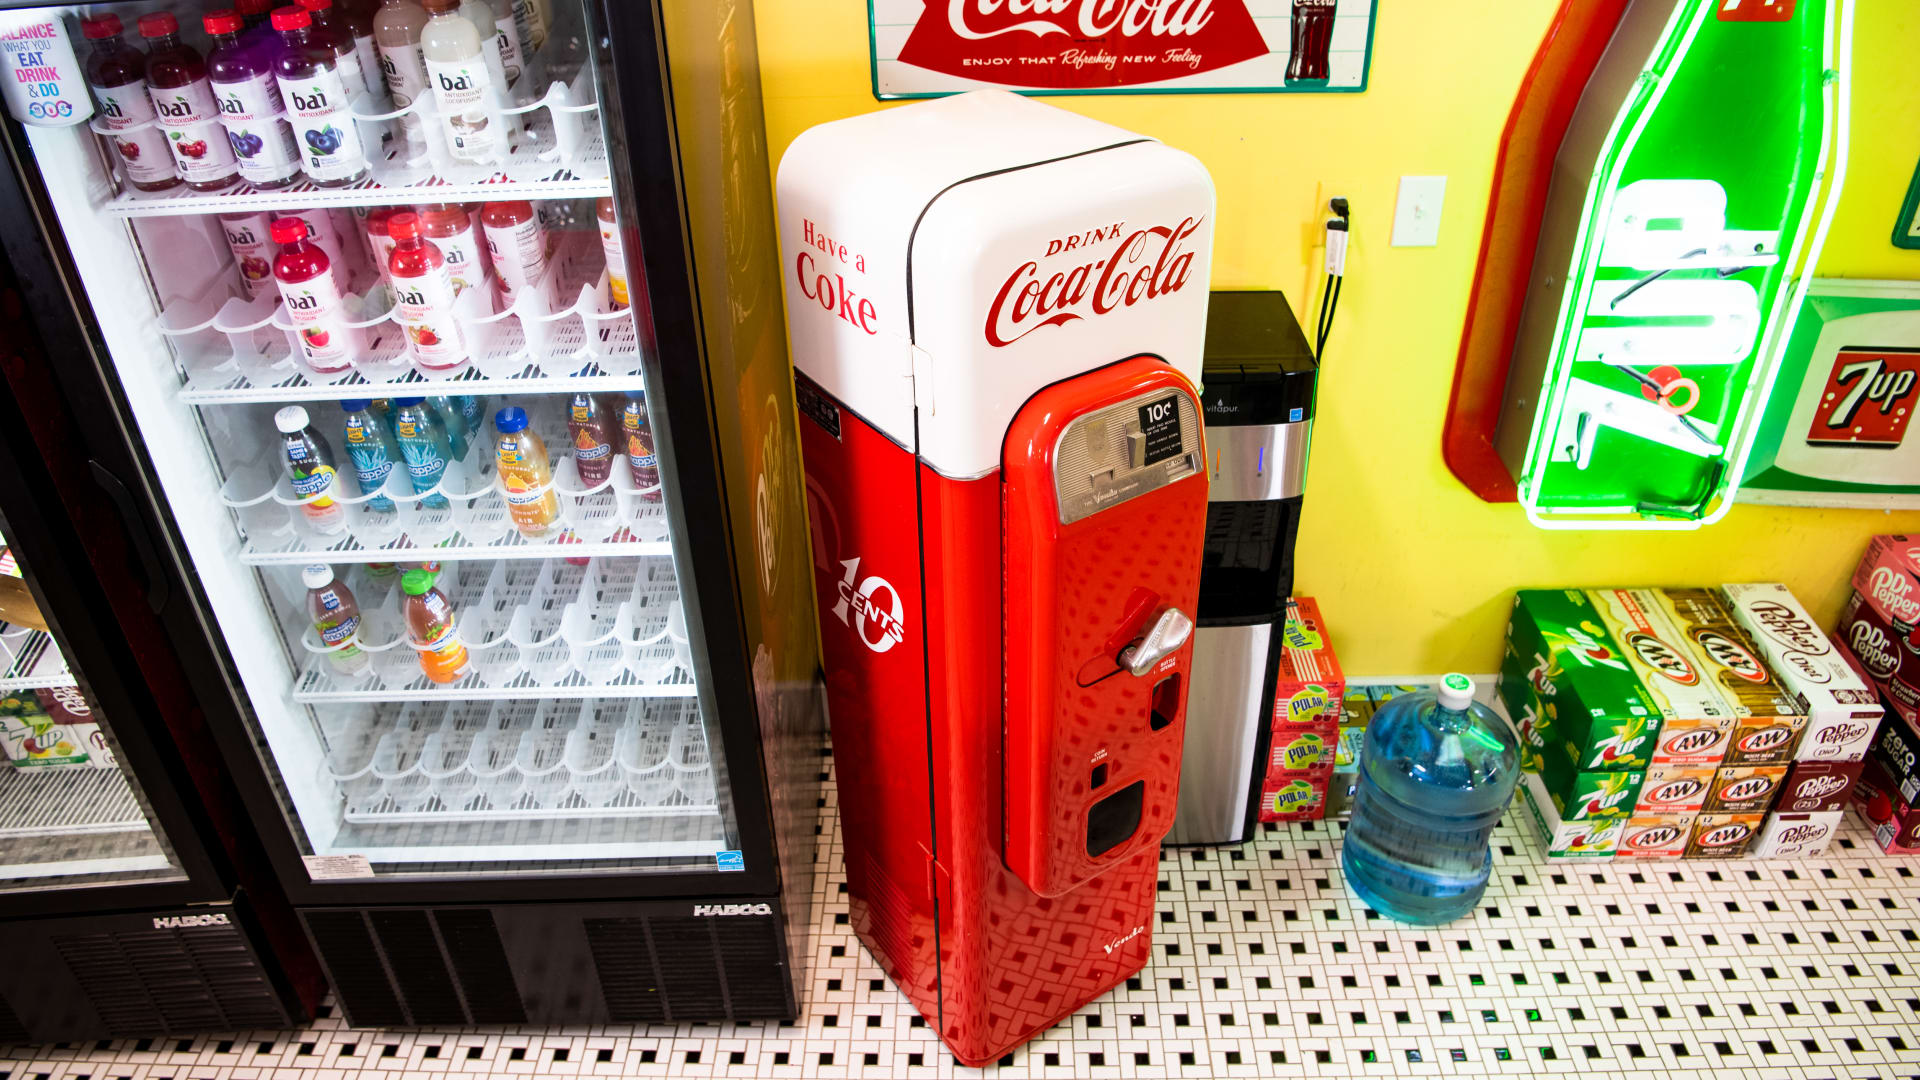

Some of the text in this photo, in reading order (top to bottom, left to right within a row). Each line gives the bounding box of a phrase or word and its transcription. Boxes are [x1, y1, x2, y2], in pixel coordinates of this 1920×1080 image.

[4, 39, 51, 52] WHAT YOU
[963, 57, 1012, 66] ENJOY
[1059, 48, 1117, 70] Refreshing
[1123, 55, 1156, 63] NEW
[1162, 48, 1202, 69] Feeling
[16, 67, 61, 82] DRINK
[438, 69, 474, 91] bai
[28, 83, 59, 98] & DO
[292, 87, 328, 110] bai
[157, 96, 192, 117] bai
[227, 227, 256, 244] bai
[1045, 222, 1126, 258] DRINK
[803, 218, 866, 275] Have a
[985, 210, 1209, 348] Coca-Cola
[286, 289, 318, 309] bai
[796, 251, 878, 335] Coke
[1551, 178, 1780, 470] 7UP
[1147, 402, 1172, 424] 10¢
[1870, 566, 1920, 614] Pepper
[1889, 573, 1913, 597] Dr
[832, 556, 904, 653] 10
[838, 580, 904, 643] CENTS
[1750, 600, 1821, 652] Pepper
[1787, 620, 1818, 639] Dr
[1850, 620, 1898, 668] Pepper
[1868, 626, 1891, 651] Dr
[1161, 656, 1176, 667] BOTTLE
[1790, 657, 1823, 678] Diet
[1292, 696, 1324, 715] POLAR
[1647, 719, 1658, 728] 12
[1836, 723, 1856, 732] Dr
[1816, 726, 1866, 744] Pepper
[1288, 745, 1319, 763] POLAR
[1588, 734, 1646, 769] 7UP
[1817, 748, 1836, 756] Diet
[1882, 738, 1911, 776] SUGAR
[1630, 774, 1640, 784] 12
[1797, 778, 1845, 798] Pepper
[1817, 775, 1836, 785] Dr
[1279, 791, 1308, 807] POLAR
[1573, 789, 1630, 820] 7UP
[1778, 827, 1825, 844] Pepper
[1798, 824, 1816, 834] Dr
[1103, 925, 1144, 954] Vendo
